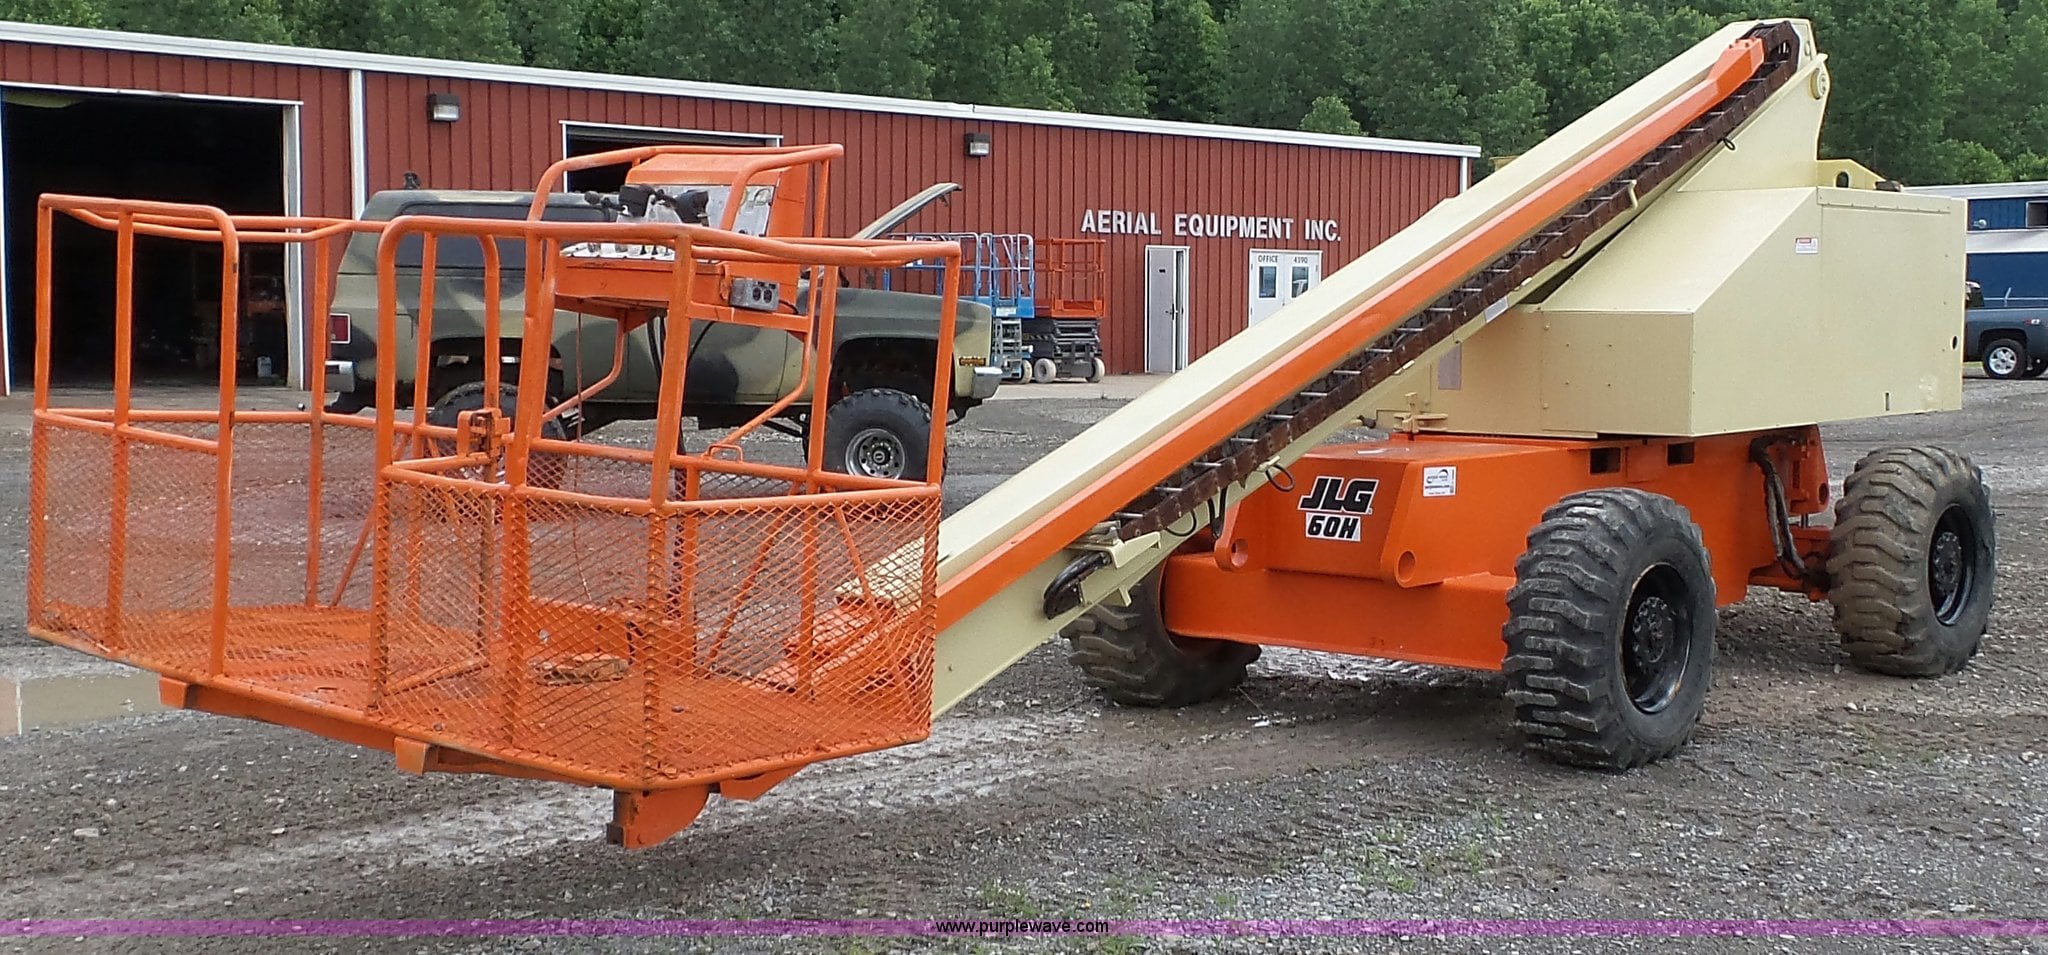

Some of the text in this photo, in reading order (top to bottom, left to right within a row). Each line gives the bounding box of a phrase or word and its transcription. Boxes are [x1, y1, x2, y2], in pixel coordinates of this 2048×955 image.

[1081, 209, 1342, 241] AERIAL EQUIPMENT INC.
[1258, 255, 1279, 263] OFFICE
[1298, 476, 1378, 514] JLG
[1307, 515, 1358, 539] 60H
